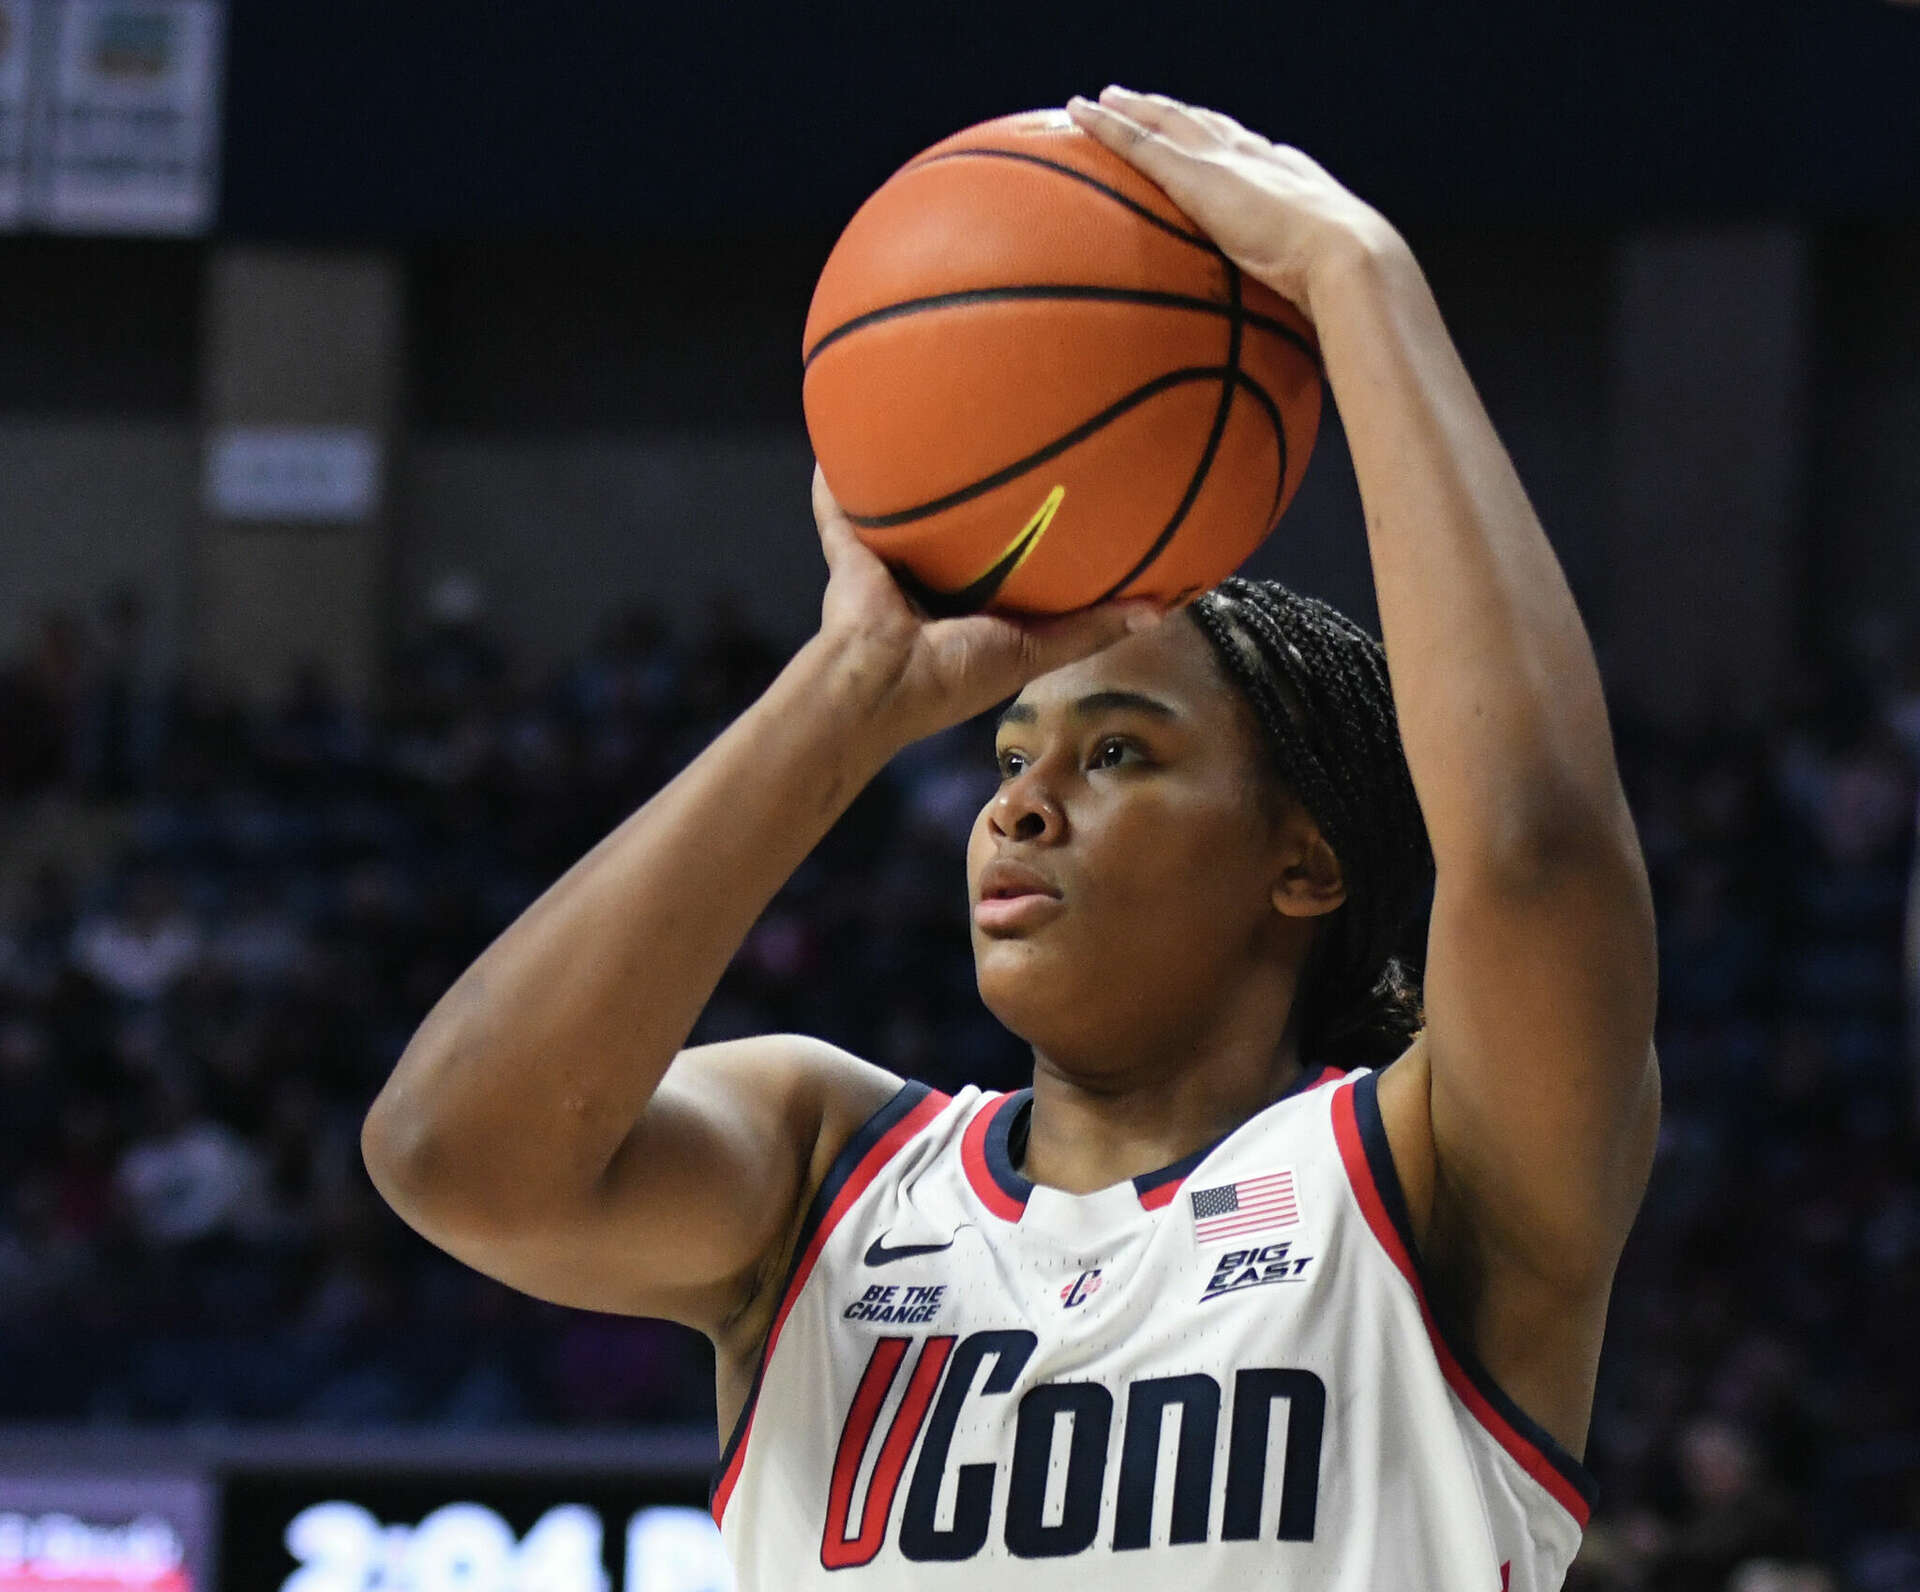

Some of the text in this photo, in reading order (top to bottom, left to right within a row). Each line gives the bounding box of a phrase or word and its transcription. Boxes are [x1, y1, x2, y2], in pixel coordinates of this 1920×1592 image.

[1218, 1242, 1293, 1272] BIG
[1206, 1257, 1314, 1291] EAST
[861, 1285, 947, 1304] BE THE
[844, 1302, 941, 1323] CHANGE
[821, 1330, 1327, 1571] UConn
